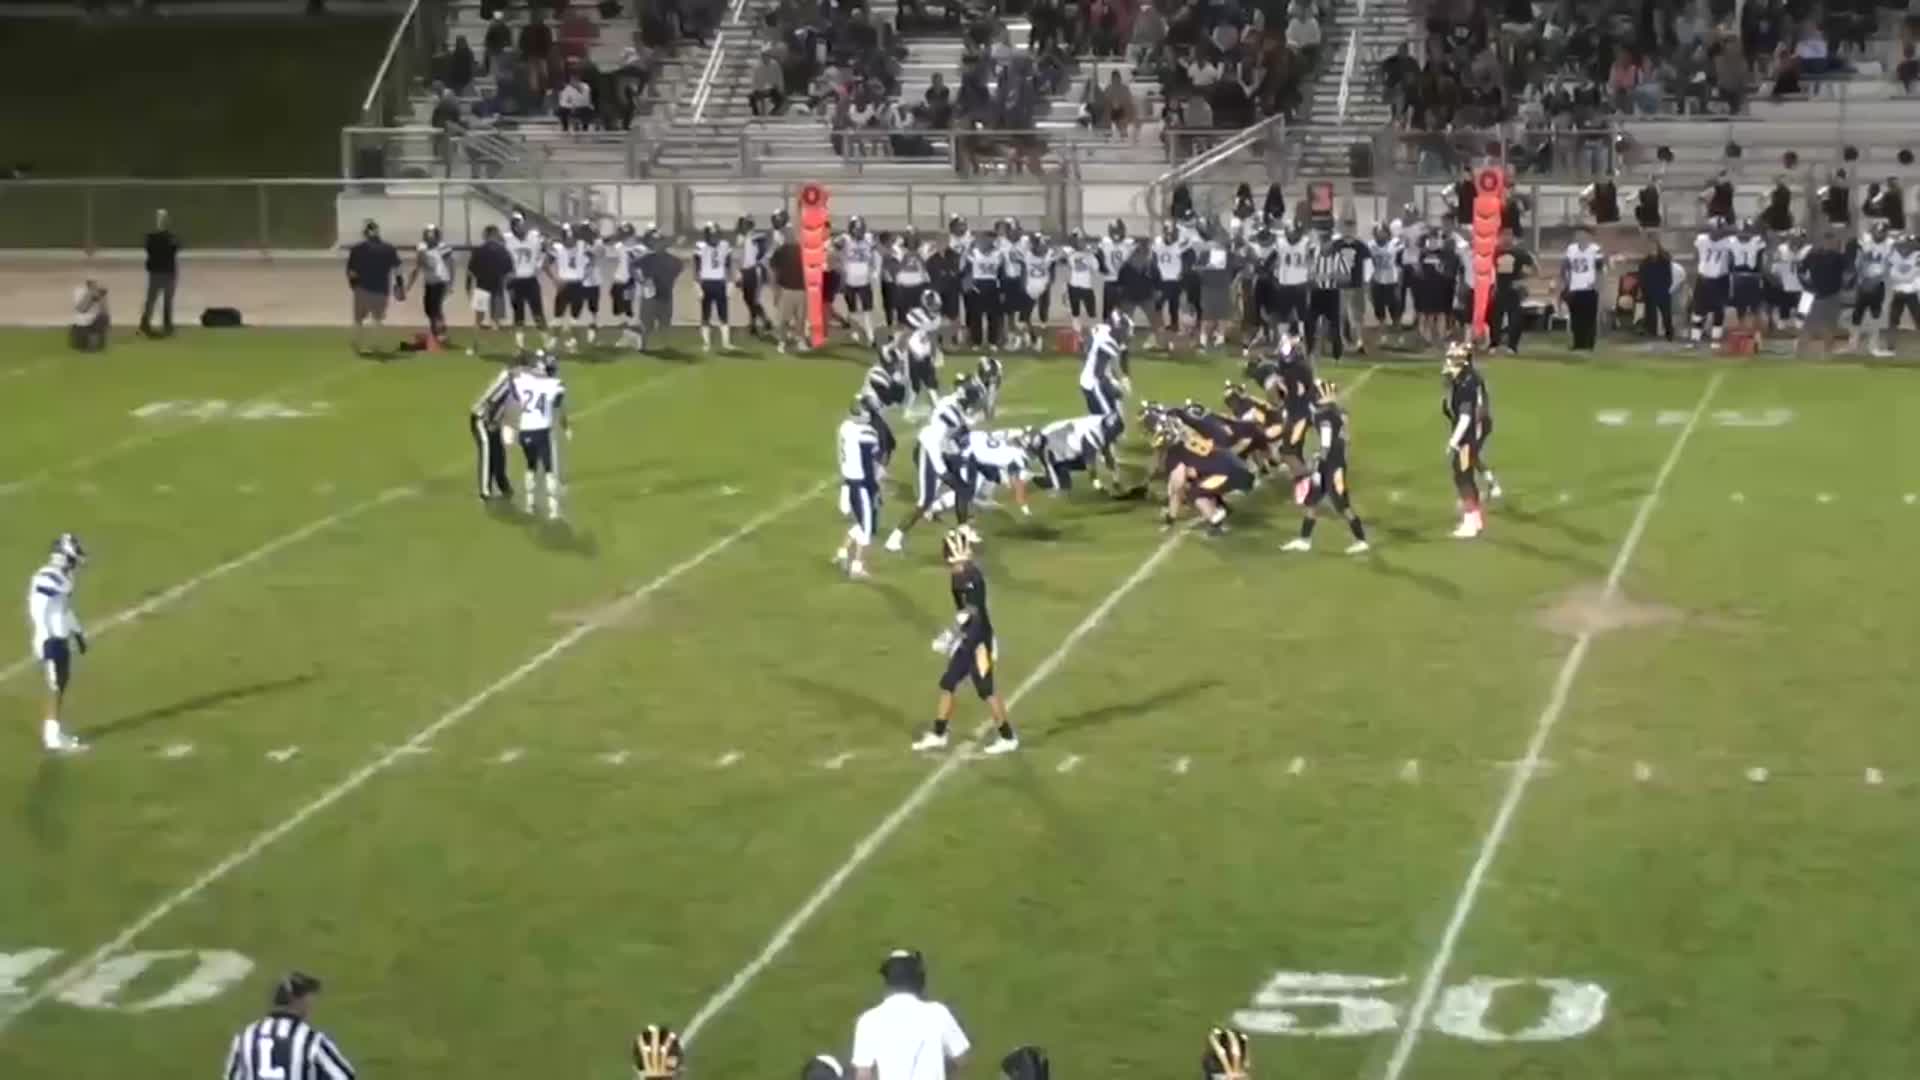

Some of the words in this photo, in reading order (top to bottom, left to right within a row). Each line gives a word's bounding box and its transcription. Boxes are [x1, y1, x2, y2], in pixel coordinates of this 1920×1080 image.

[522, 389, 546, 417] 24
[1232, 971, 1609, 1041] 50
[257, 1036, 285, 1079] L
